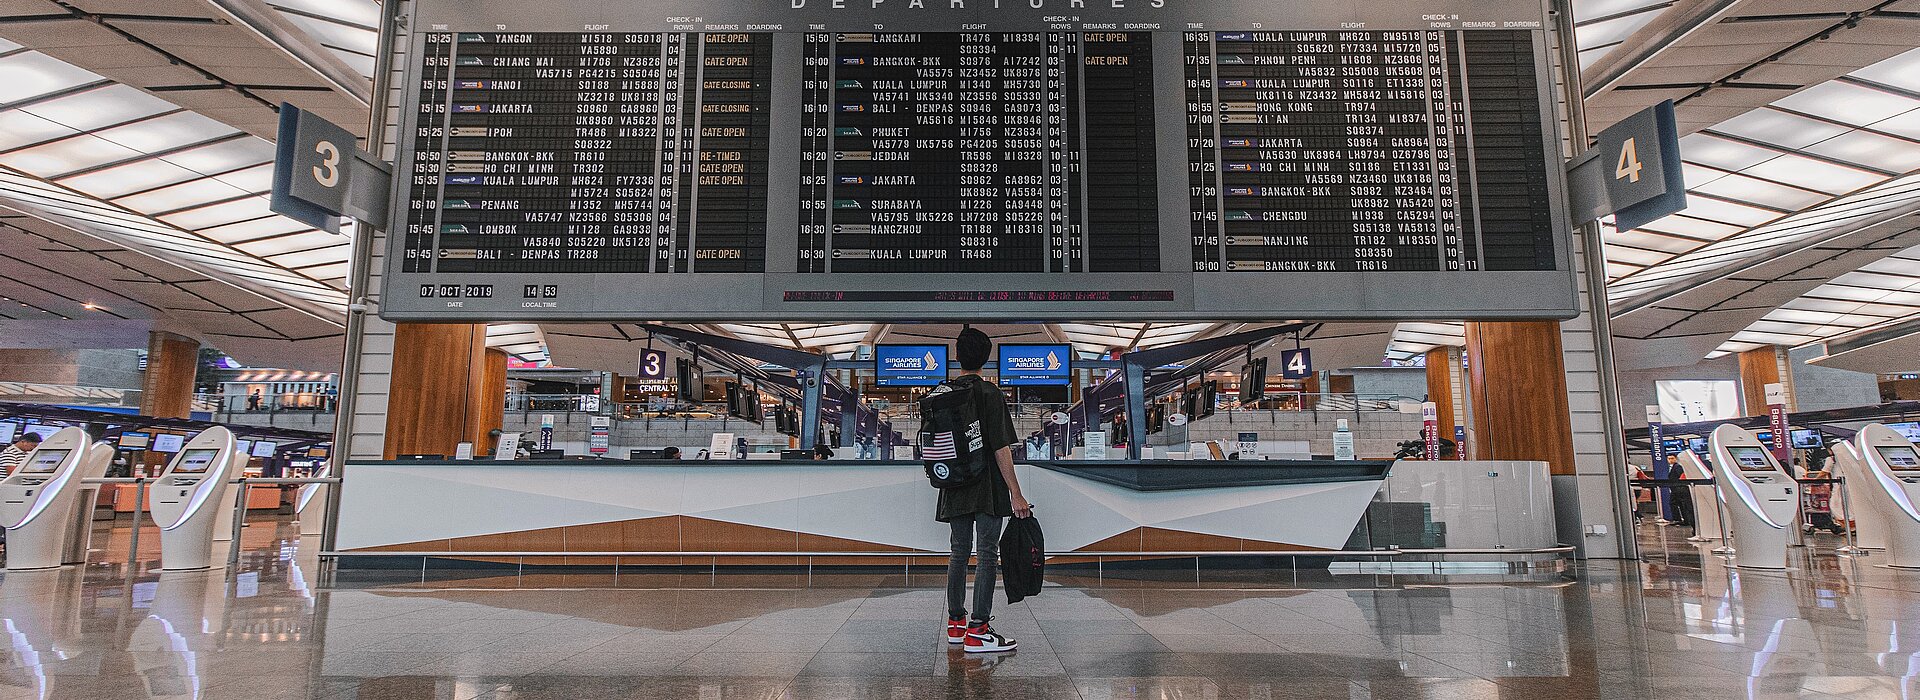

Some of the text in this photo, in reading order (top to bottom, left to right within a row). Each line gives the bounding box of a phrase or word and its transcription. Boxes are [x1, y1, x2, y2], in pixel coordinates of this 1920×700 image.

[496, 35, 531, 43] YANGON
[706, 34, 748, 42] GATE OPEN
[874, 34, 920, 42] LANGKAWI
[1253, 33, 1326, 41] KUALA LUMPUR
[581, 46, 617, 54] VA5890
[1341, 44, 1377, 52] FY7334
[494, 58, 553, 66] CHIANG MAI
[874, 57, 1039, 65] BANGKOK-BKK AI7242
[1086, 57, 1127, 65] GATE OPEN
[1255, 56, 1315, 64] PHNOM PENH
[536, 69, 615, 77] VA5715 PG4215
[917, 69, 996, 77] VA5575 NZ3452
[1299, 68, 1334, 76] VA5832
[492, 81, 520, 89] HANOI
[873, 81, 946, 89] KUALA LUMPUR
[1256, 79, 1423, 88] KUALA LUMPUR ET1338
[578, 93, 614, 101] NZ3218
[873, 92, 952, 101] VA5741 UK5340
[1256, 91, 1336, 99] UK8116 NZ3432
[490, 105, 532, 113] JAKARTA
[873, 104, 1040, 112] BALI DENPAS GA9073
[1257, 103, 1281, 111] HONG
[1288, 103, 1312, 111] KONG
[1345, 103, 1375, 111] TR974
[1346, 115, 1376, 123] TR134
[489, 128, 606, 137] IPOH TR486
[702, 128, 744, 136] GATE OPEN
[873, 128, 907, 136] PHUKET
[873, 140, 997, 148] VA5779 PG4205
[1260, 139, 1302, 147] JAKARTA
[486, 152, 553, 160] BANGKOK-BKK
[701, 152, 740, 160] RE-TIMED
[873, 152, 909, 160] JEDDAH
[1349, 150, 1385, 159] LH9794
[313, 141, 340, 187] 3
[1616, 137, 1642, 183] 4
[485, 164, 603, 173] HO CHI MINH TR302
[700, 164, 743, 172] GATE OPEN
[1260, 162, 1429, 171] HO CHI MINH ET1331
[484, 176, 558, 185] KUALA LUMPUR
[700, 176, 742, 184] GATE OPEN
[872, 176, 915, 184] JAKARTA
[1305, 175, 1342, 183] VA5569
[1262, 187, 1330, 196] BANGKOK-BKK
[482, 201, 518, 209] PENANG
[872, 200, 921, 209] SURABAYA
[526, 213, 562, 221] VA5747
[872, 213, 998, 221] VA5795 LH7208
[1263, 211, 1434, 220] CHENGDU CA5294
[480, 225, 516, 234] LOMBOK
[871, 225, 921, 234] HANGZHOU
[1398, 224, 1435, 232] VA5813
[1264, 236, 1385, 245] NANJING TR182
[478, 250, 500, 259] BALI
[522, 250, 559, 259] DENPAS
[696, 250, 740, 258] GATE OPEN
[871, 250, 901, 259] KUALA
[910, 250, 946, 258] LUMPUR
[1266, 261, 1335, 270] BANGKOK-BKK
[526, 286, 557, 297] 14:53
[645, 353, 660, 376] 3
[1288, 352, 1307, 374] 4
[1770, 408, 1783, 449] Bag-Drop
